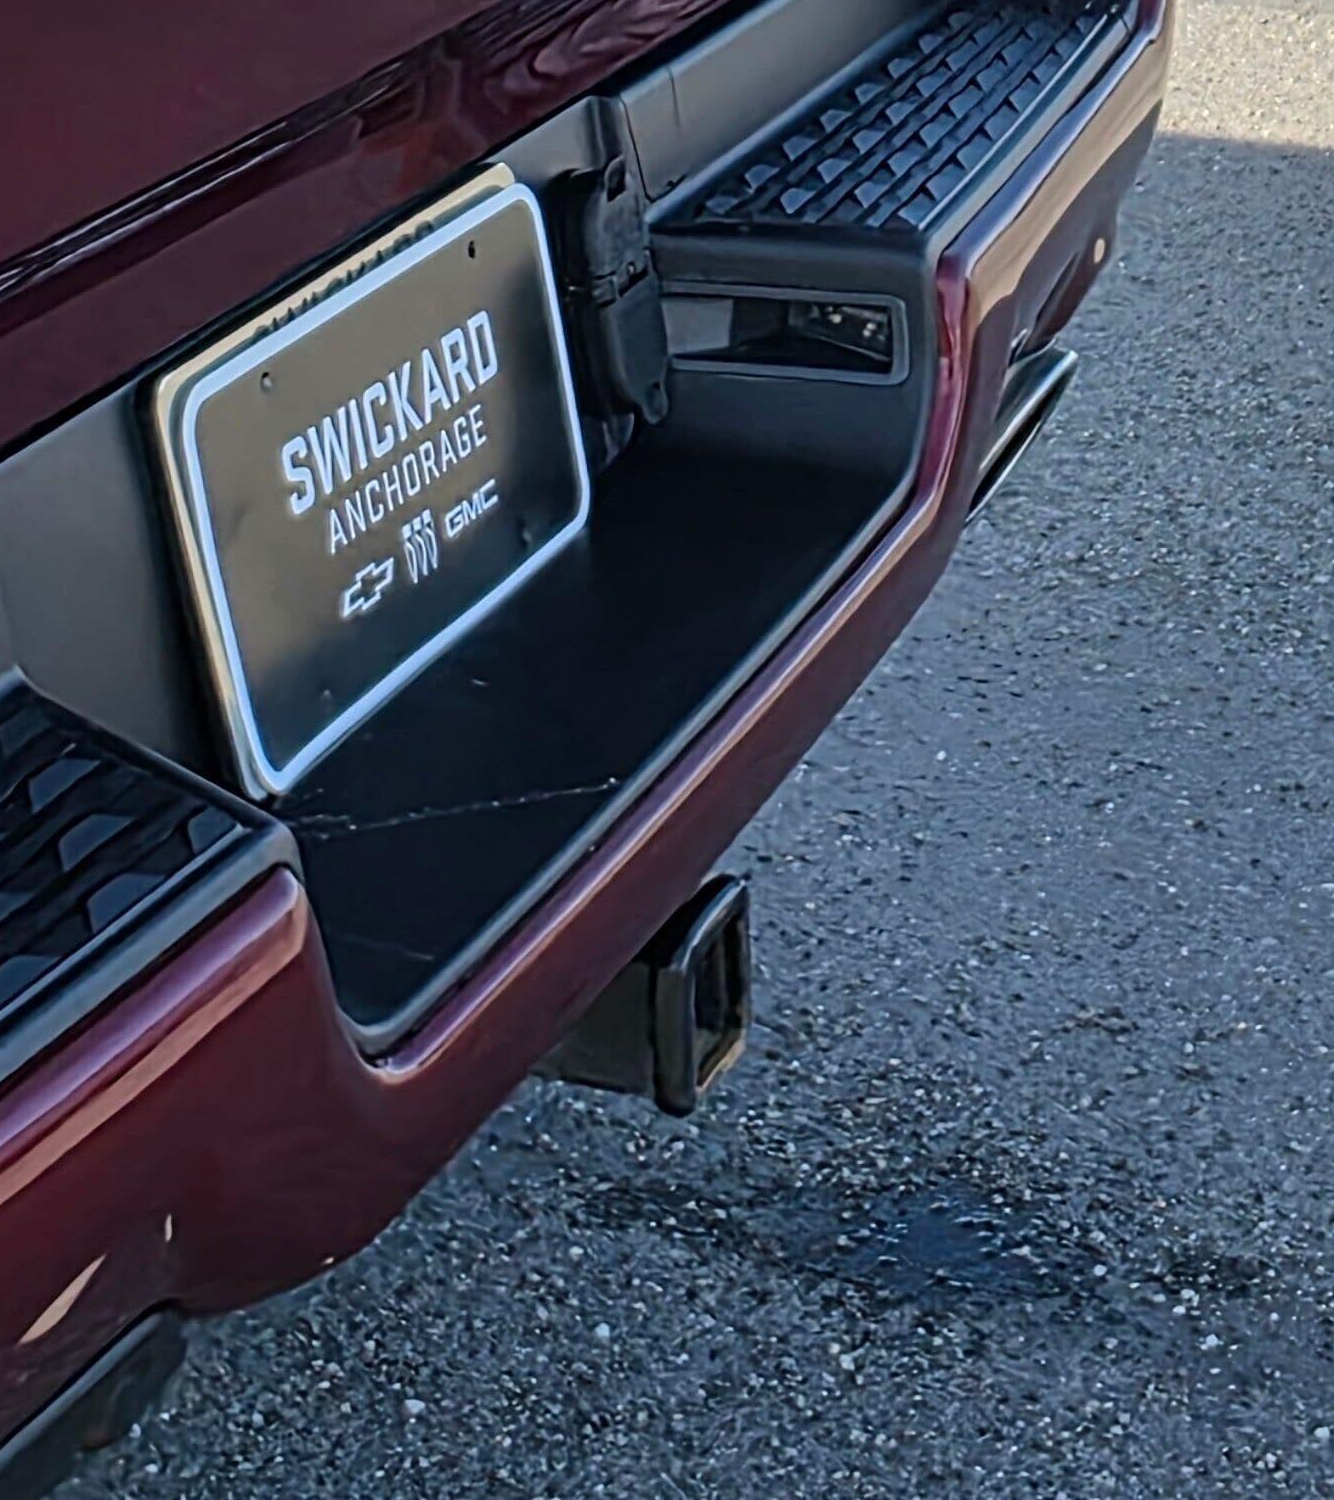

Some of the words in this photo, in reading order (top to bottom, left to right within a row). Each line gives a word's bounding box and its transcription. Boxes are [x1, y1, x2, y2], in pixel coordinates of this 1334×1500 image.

[280, 310, 498, 515] SWICKARD
[328, 403, 487, 555] ANCHORAGE
[444, 478, 499, 538] GMC
